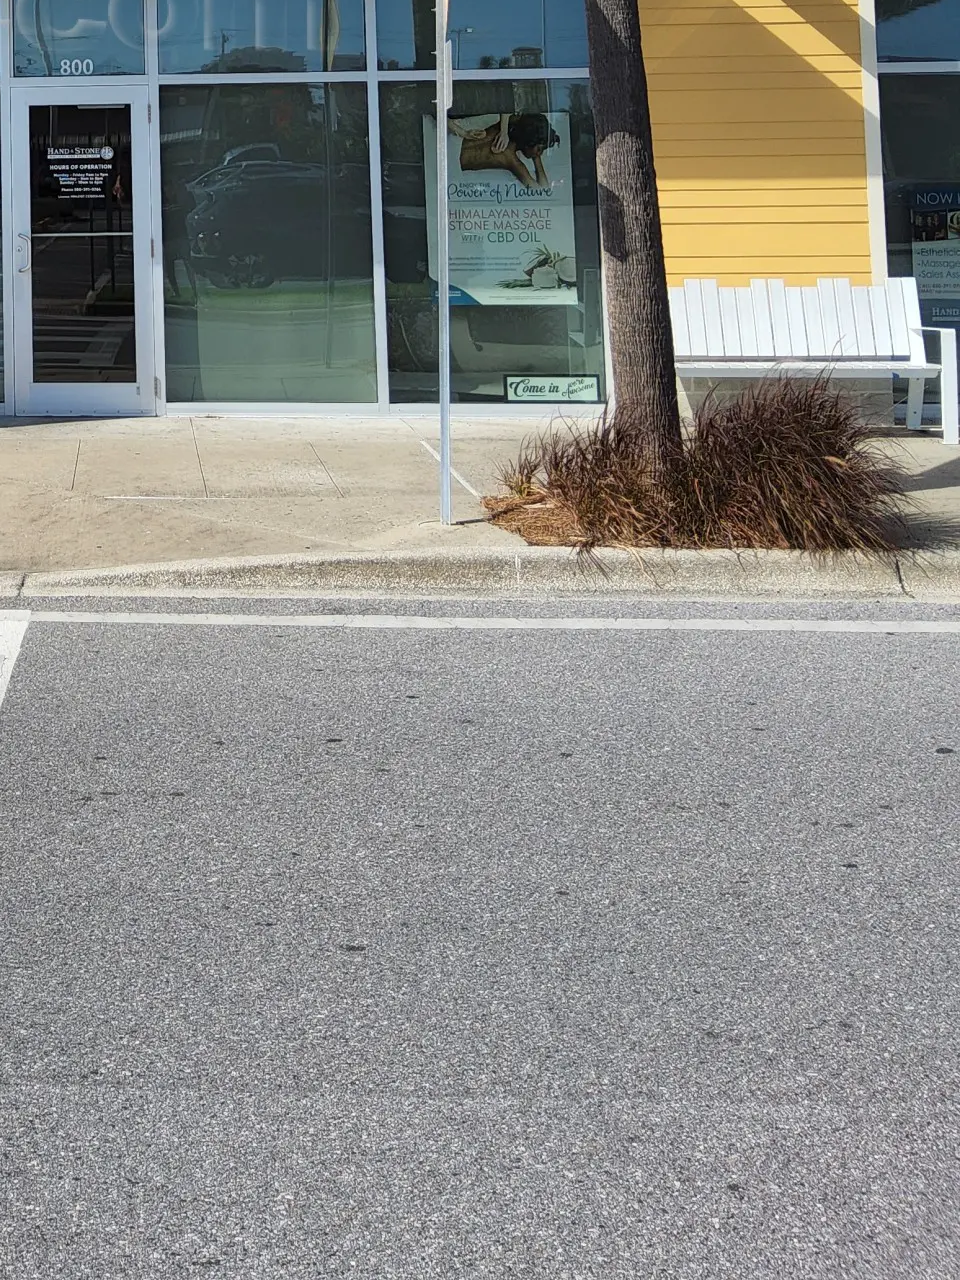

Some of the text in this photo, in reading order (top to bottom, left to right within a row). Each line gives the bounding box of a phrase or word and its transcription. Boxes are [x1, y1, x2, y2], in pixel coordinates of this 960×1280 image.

[60, 58, 94, 75] 800
[47, 147, 70, 155] HAND
[74, 147, 101, 155] STONE
[447, 182, 553, 204] Power of Nature
[916, 192, 953, 204] NOW
[448, 208, 552, 219] HIMALAYAN SALT
[448, 220, 552, 231] STONE MASSAGE
[461, 231, 541, 243] WITH CBD OIL
[932, 306, 960, 316] HAND
[509, 378, 560, 397] Come in
